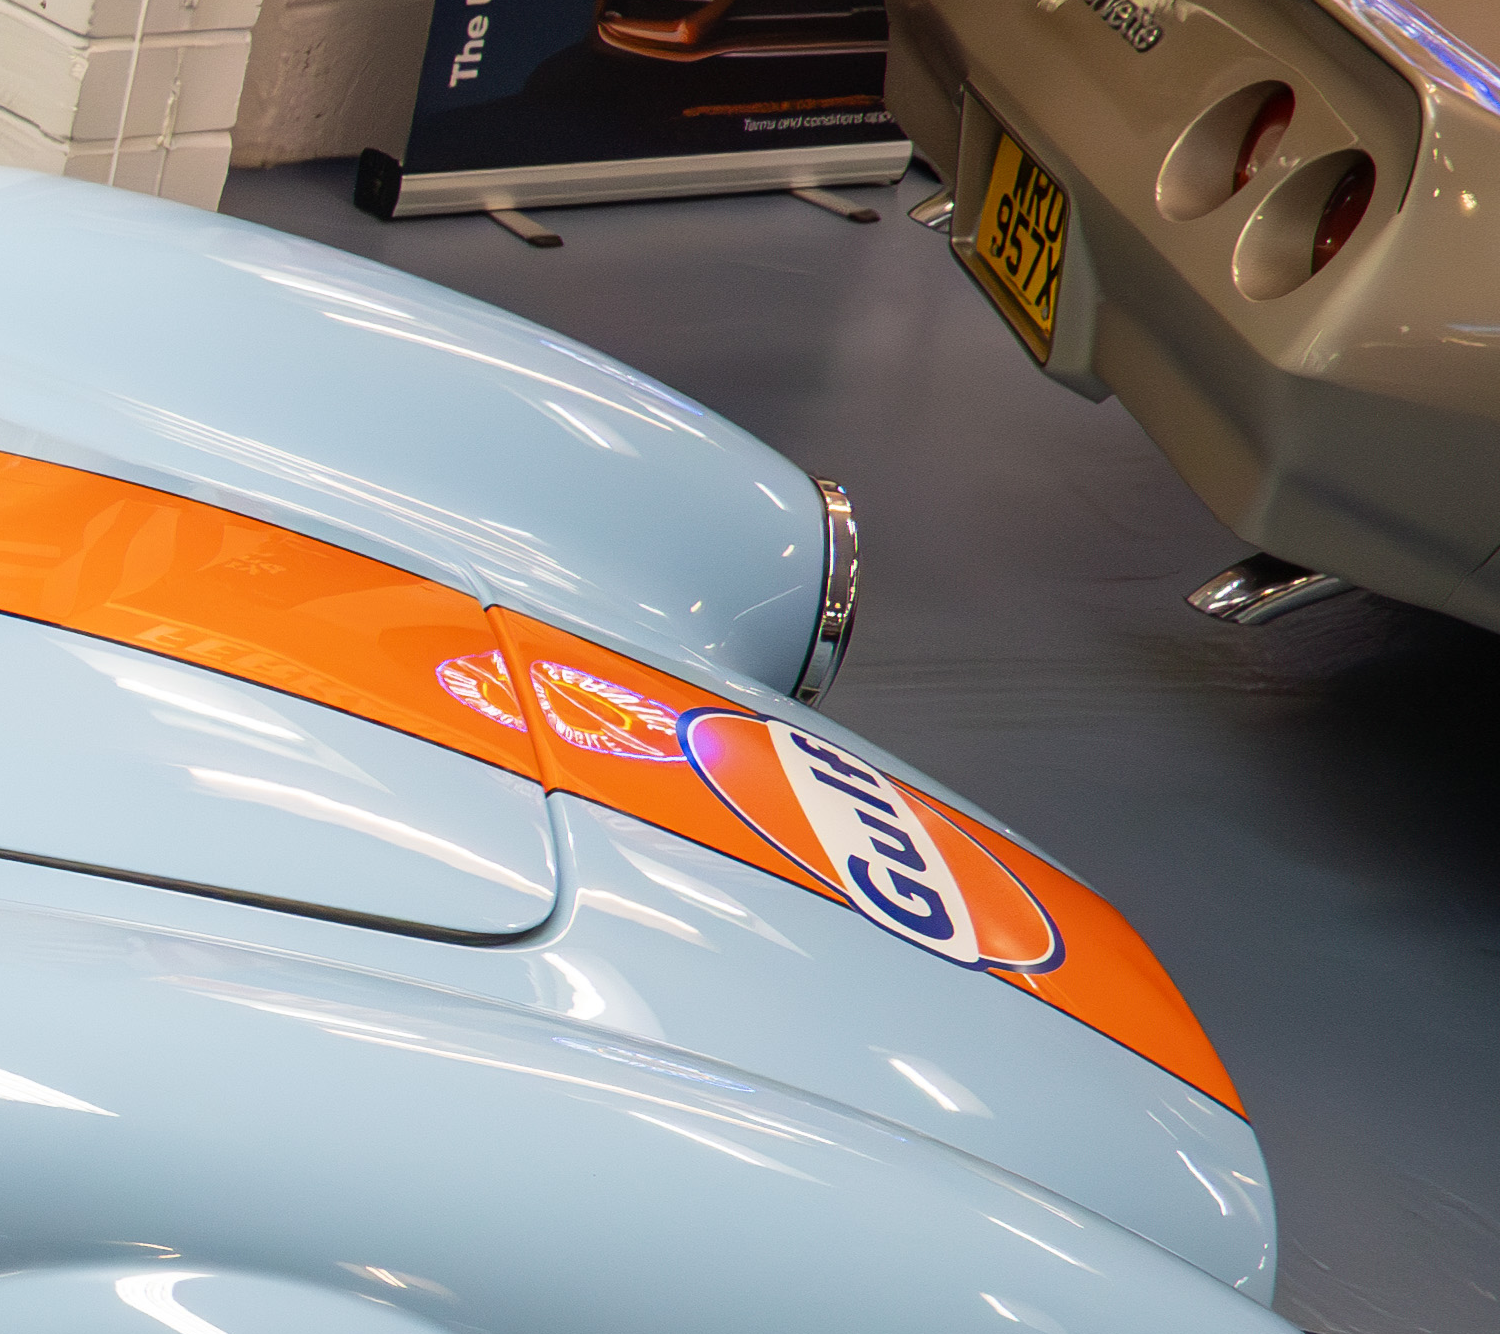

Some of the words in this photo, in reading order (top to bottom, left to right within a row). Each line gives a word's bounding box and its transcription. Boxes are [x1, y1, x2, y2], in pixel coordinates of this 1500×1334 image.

[449, 14, 489, 89] The
[991, 193, 1061, 322] 957X
[790, 732, 954, 941] Gulf
